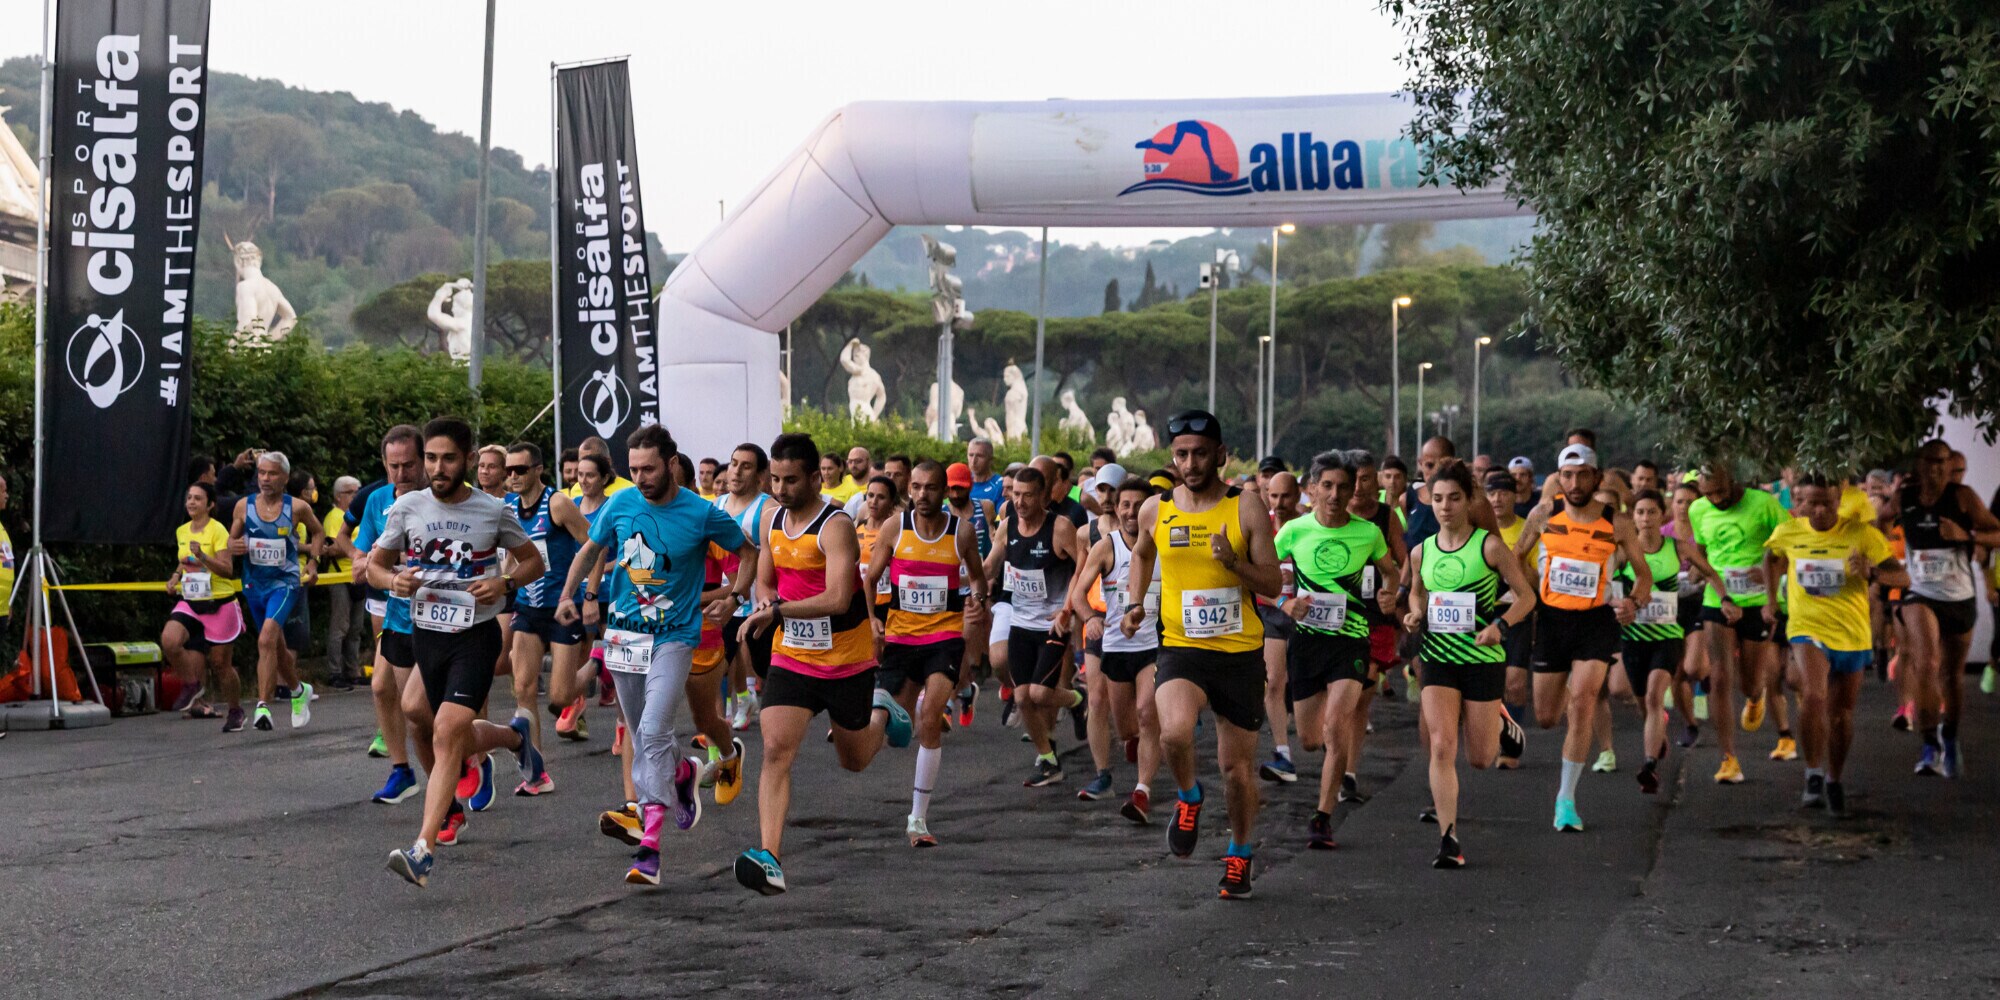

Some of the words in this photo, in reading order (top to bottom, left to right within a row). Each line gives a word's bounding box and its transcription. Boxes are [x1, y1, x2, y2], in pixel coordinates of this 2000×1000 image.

[72, 78, 92, 228] SPORT
[1249, 131, 1484, 192] albara
[86, 33, 140, 295] cisalfa
[160, 34, 202, 407] #IAMTHESPORT
[580, 162, 618, 356] cisalfa
[616, 160, 659, 427] #IAMTHESPORT
[446, 521, 458, 530] DO
[460, 523, 471, 533] IT
[256, 549, 280, 560] 1270
[189, 583, 200, 593] 49
[1016, 580, 1038, 592] 1516
[1559, 572, 1588, 588] 1644
[911, 590, 932, 604] 911
[430, 604, 458, 623] 687
[1198, 606, 1227, 625] 942
[1309, 606, 1331, 621] 827
[1437, 608, 1460, 623] 890
[791, 620, 815, 638] 923
